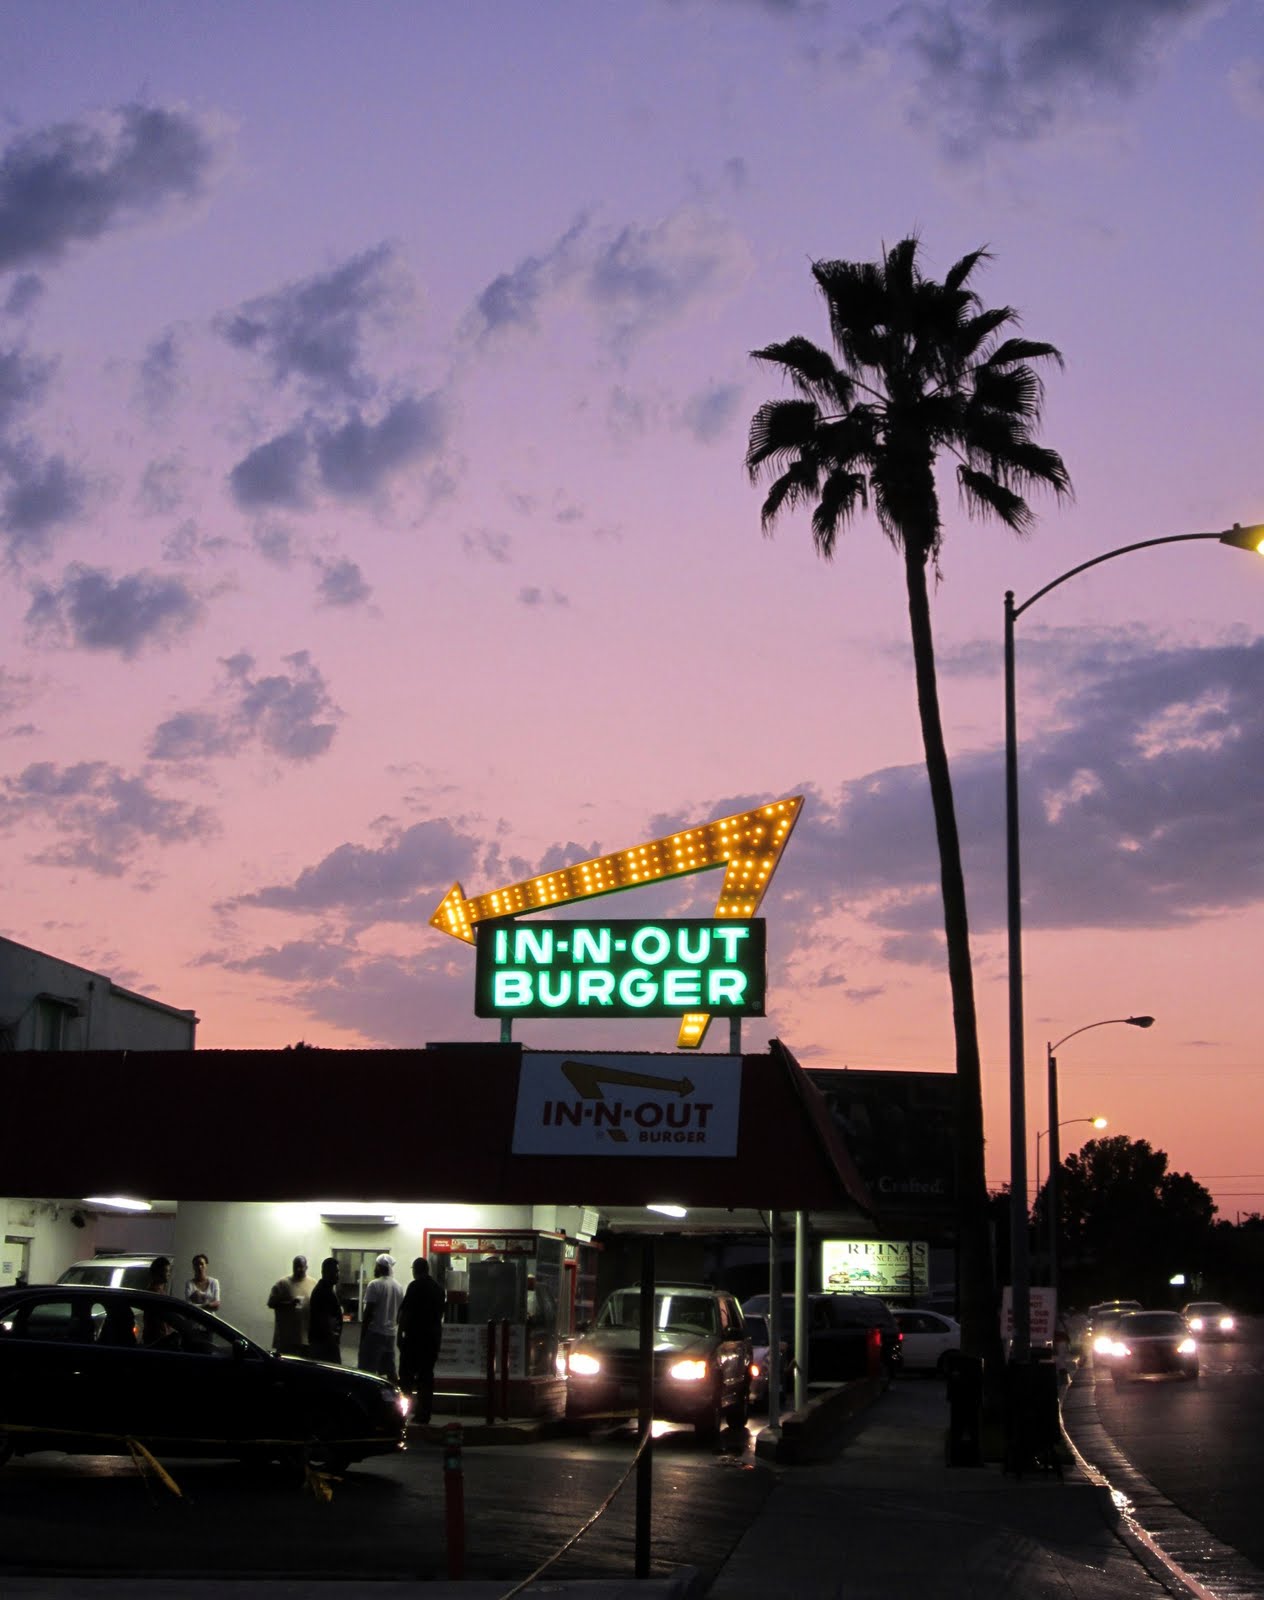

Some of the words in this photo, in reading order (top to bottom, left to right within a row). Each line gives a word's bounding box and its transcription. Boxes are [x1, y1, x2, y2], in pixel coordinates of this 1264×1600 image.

[494, 926, 750, 965] IN-N-OUT
[494, 968, 748, 1007] BURGER
[639, 1131, 706, 1143] BURGER
[848, 1243, 926, 1256] REINAS
